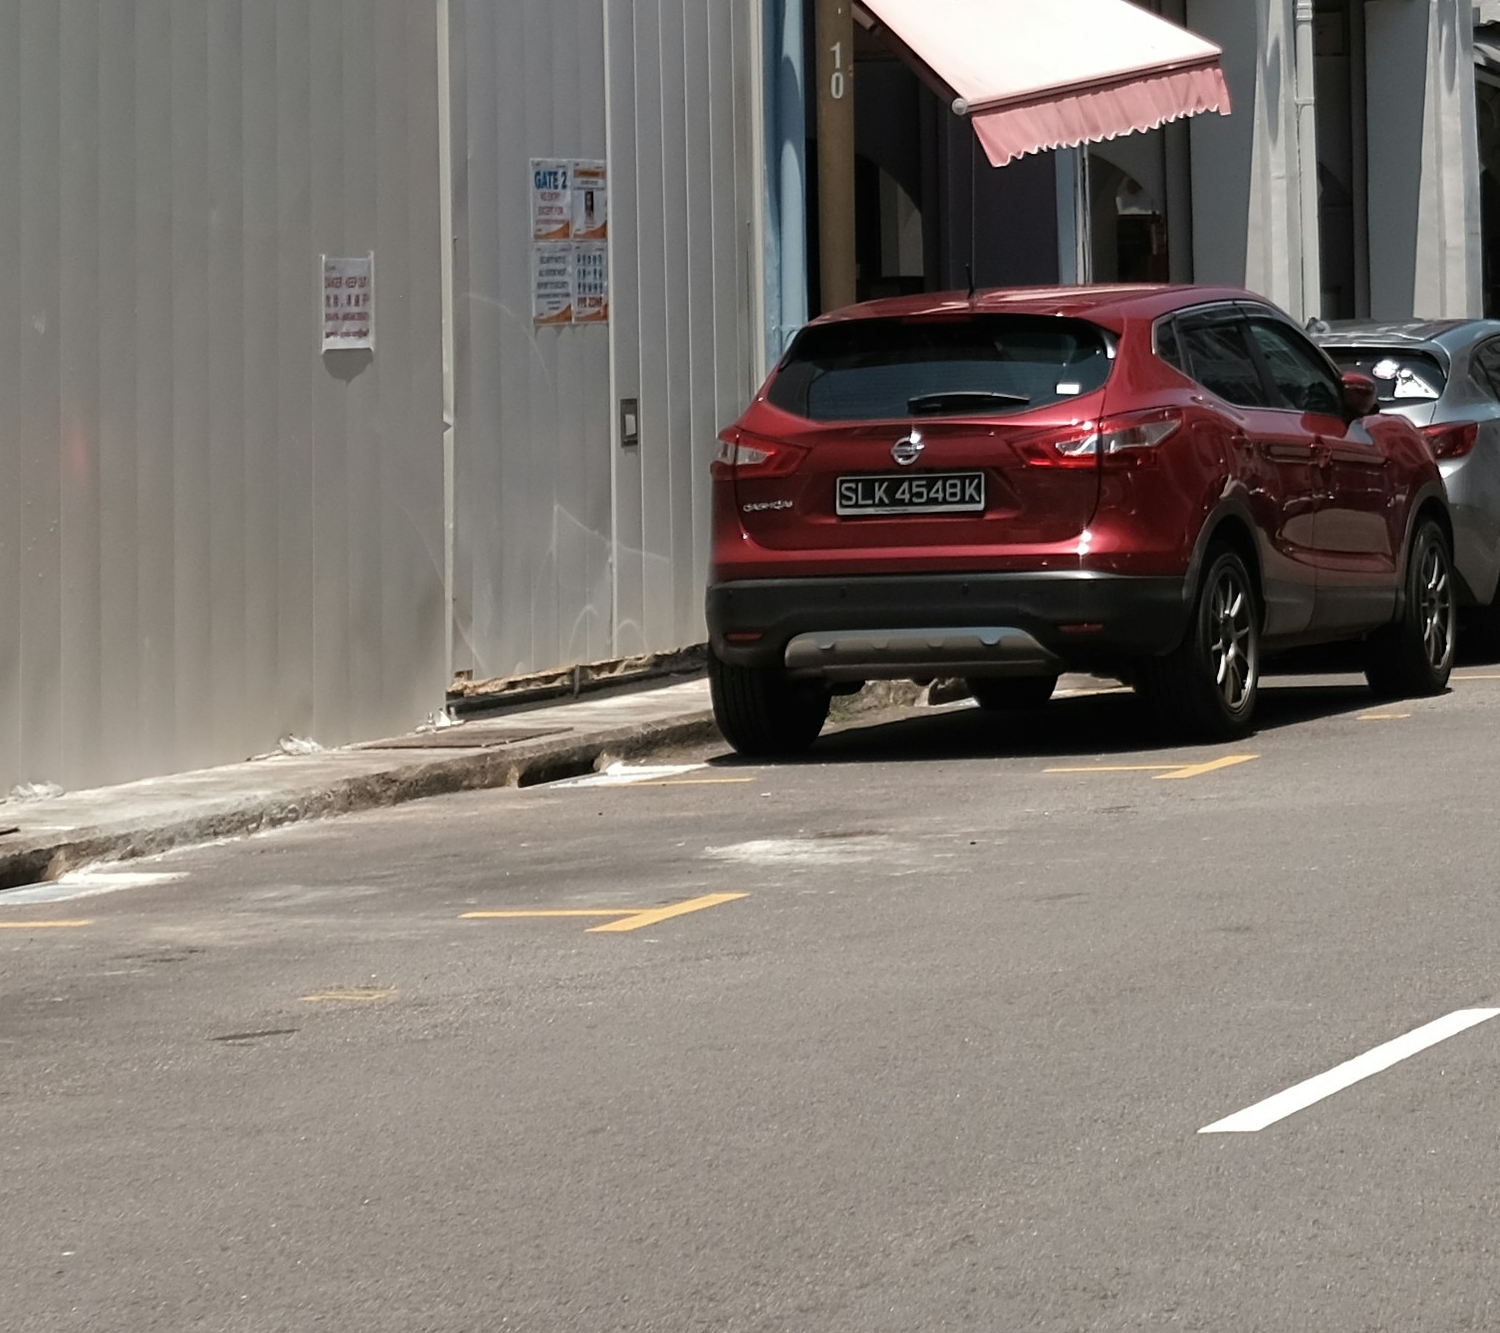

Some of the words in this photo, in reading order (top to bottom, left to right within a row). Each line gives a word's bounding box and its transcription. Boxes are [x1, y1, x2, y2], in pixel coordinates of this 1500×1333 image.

[829, 41, 845, 100] 10
[534, 170, 558, 191] GATE
[560, 170, 568, 190] 2
[840, 481, 890, 506] SLK
[894, 478, 980, 503] 4548K
